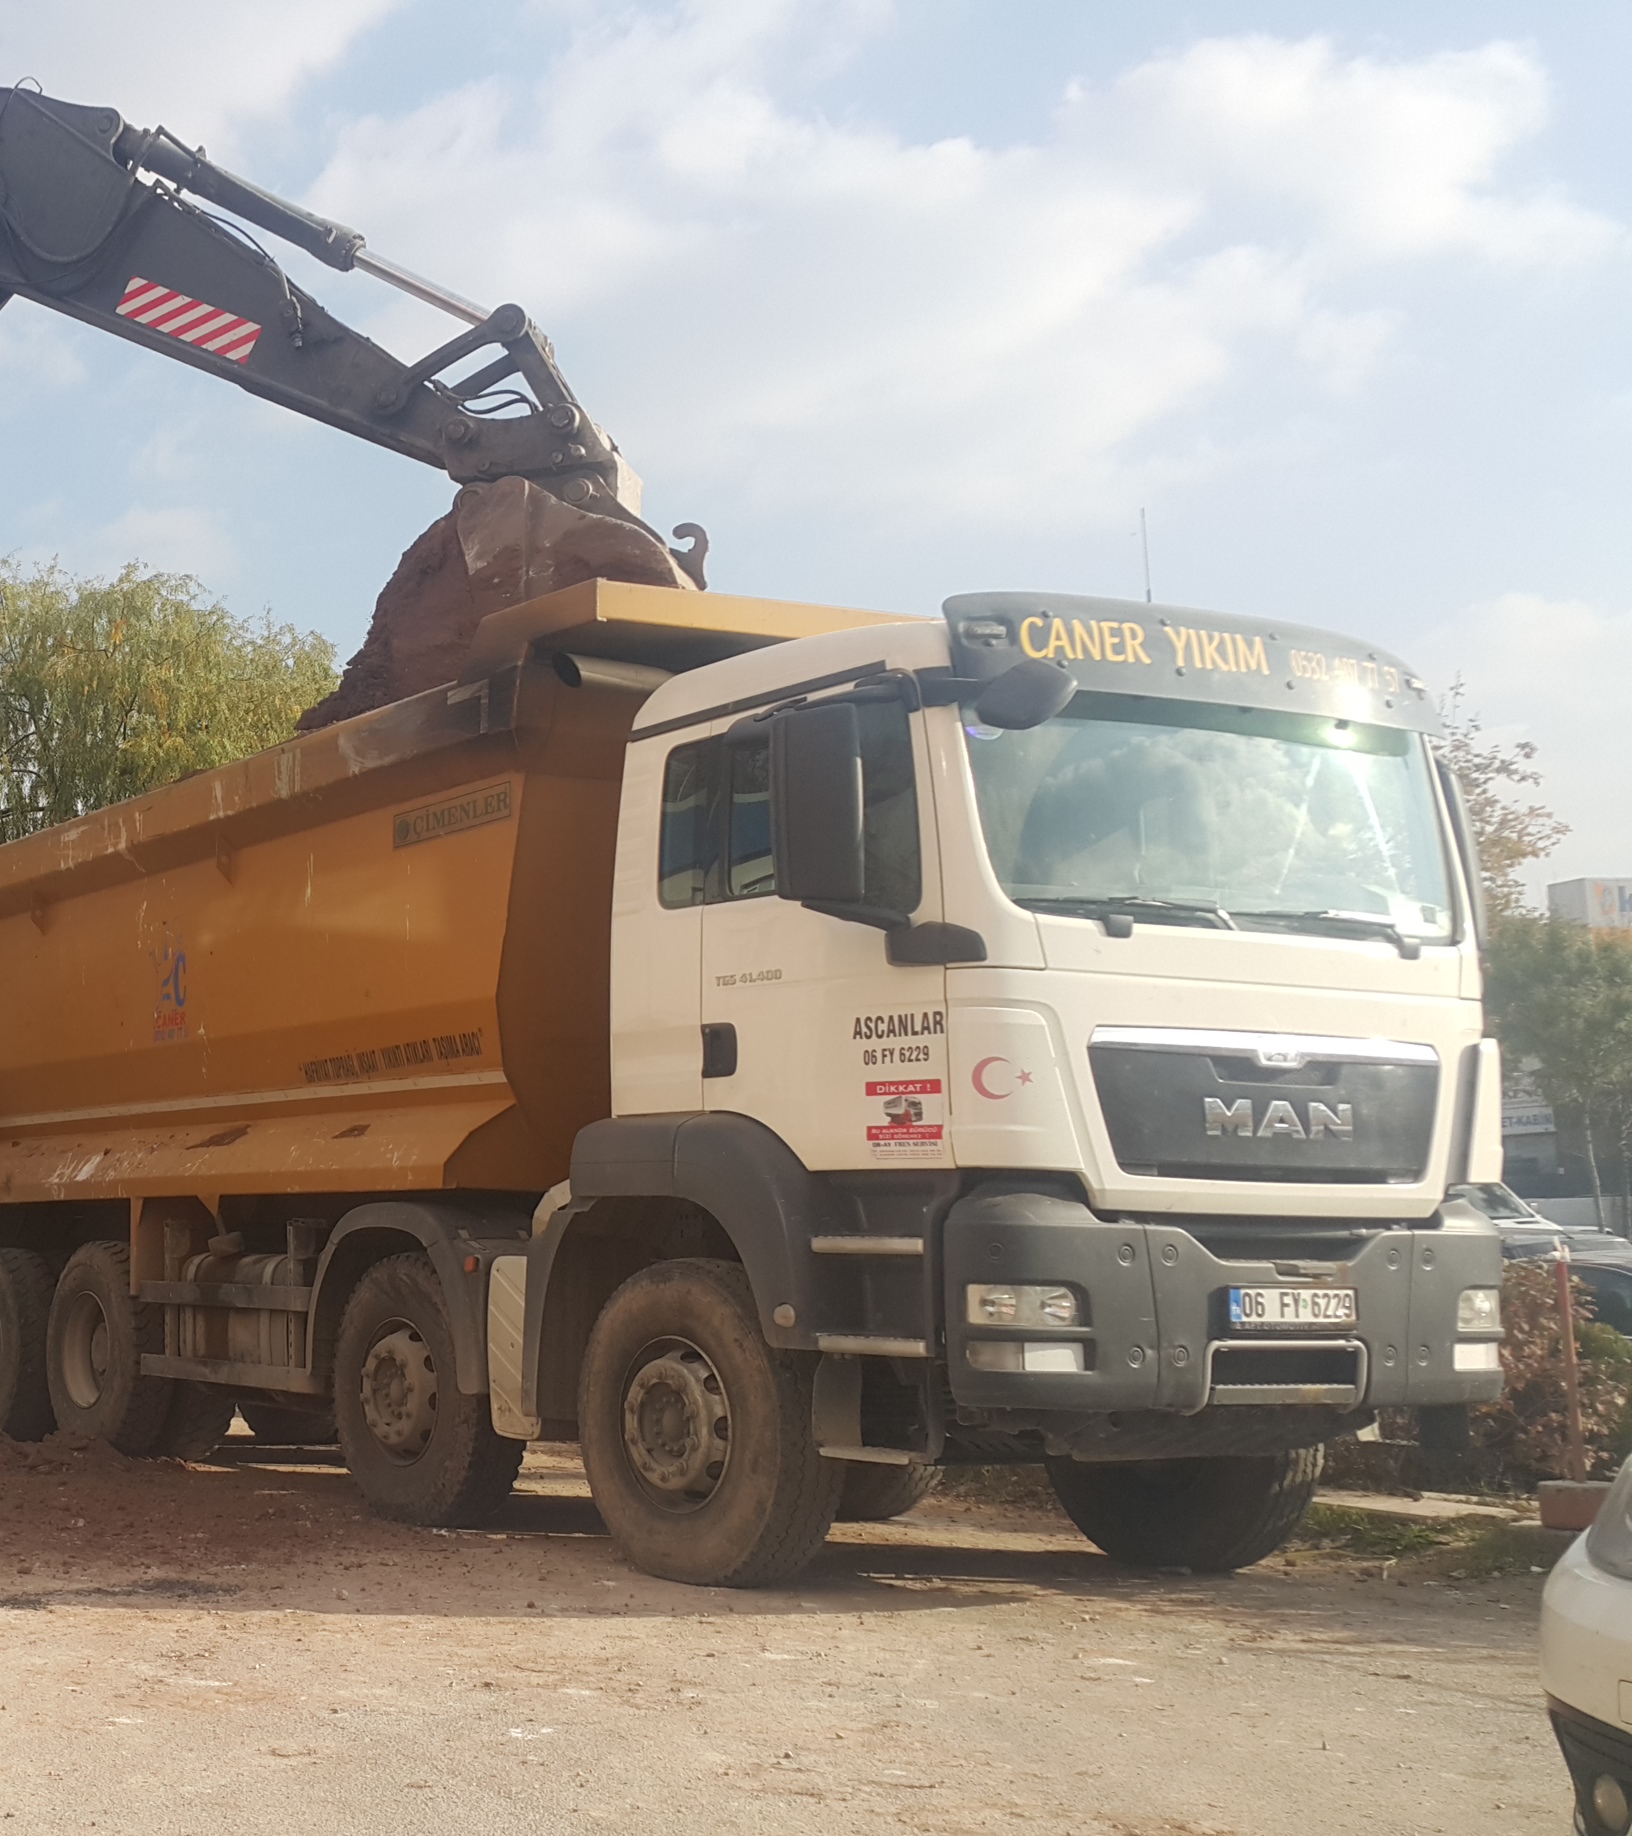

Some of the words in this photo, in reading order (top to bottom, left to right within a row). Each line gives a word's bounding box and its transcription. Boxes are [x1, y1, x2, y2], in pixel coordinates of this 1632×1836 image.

[1019, 615, 1152, 665] CANER
[1163, 625, 1271, 676] YIKIM
[413, 789, 510, 839] ÇİMENLER
[853, 1010, 945, 1040] ASCANLAR
[863, 1049, 878, 1066] 06
[881, 1047, 896, 1065] FY
[899, 1045, 929, 1063] 6229
[876, 1083, 922, 1093] DİKKAT
[1203, 1097, 1353, 1141] MAN
[1242, 1291, 1266, 1319] 06
[1279, 1291, 1302, 1319] FY
[1311, 1292, 1353, 1319] 6229
